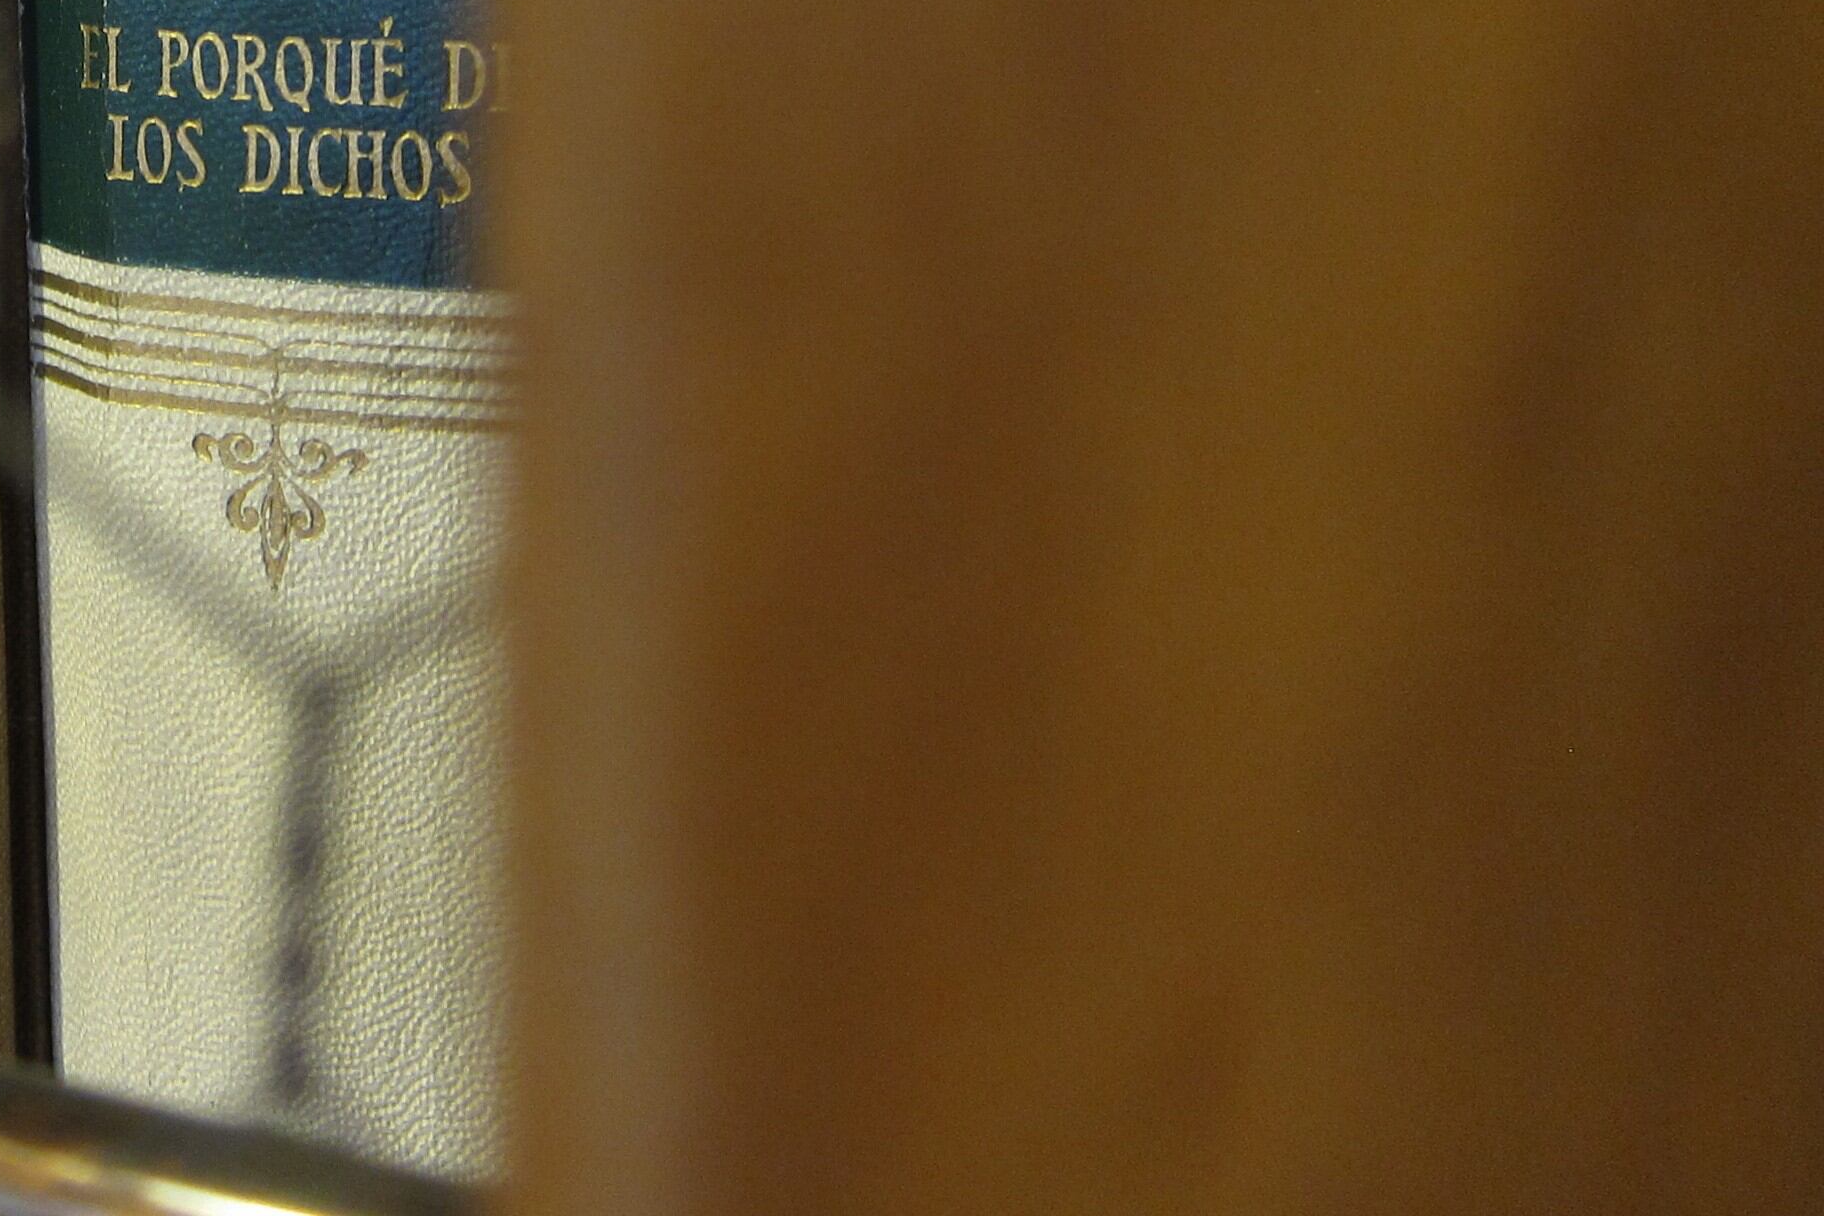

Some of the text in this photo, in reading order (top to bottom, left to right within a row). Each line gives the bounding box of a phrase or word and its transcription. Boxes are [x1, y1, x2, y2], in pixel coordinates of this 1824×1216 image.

[79, 22, 131, 94] EL
[156, 16, 409, 112] PORQUÉ
[105, 111, 473, 209] LOS DICHOS
